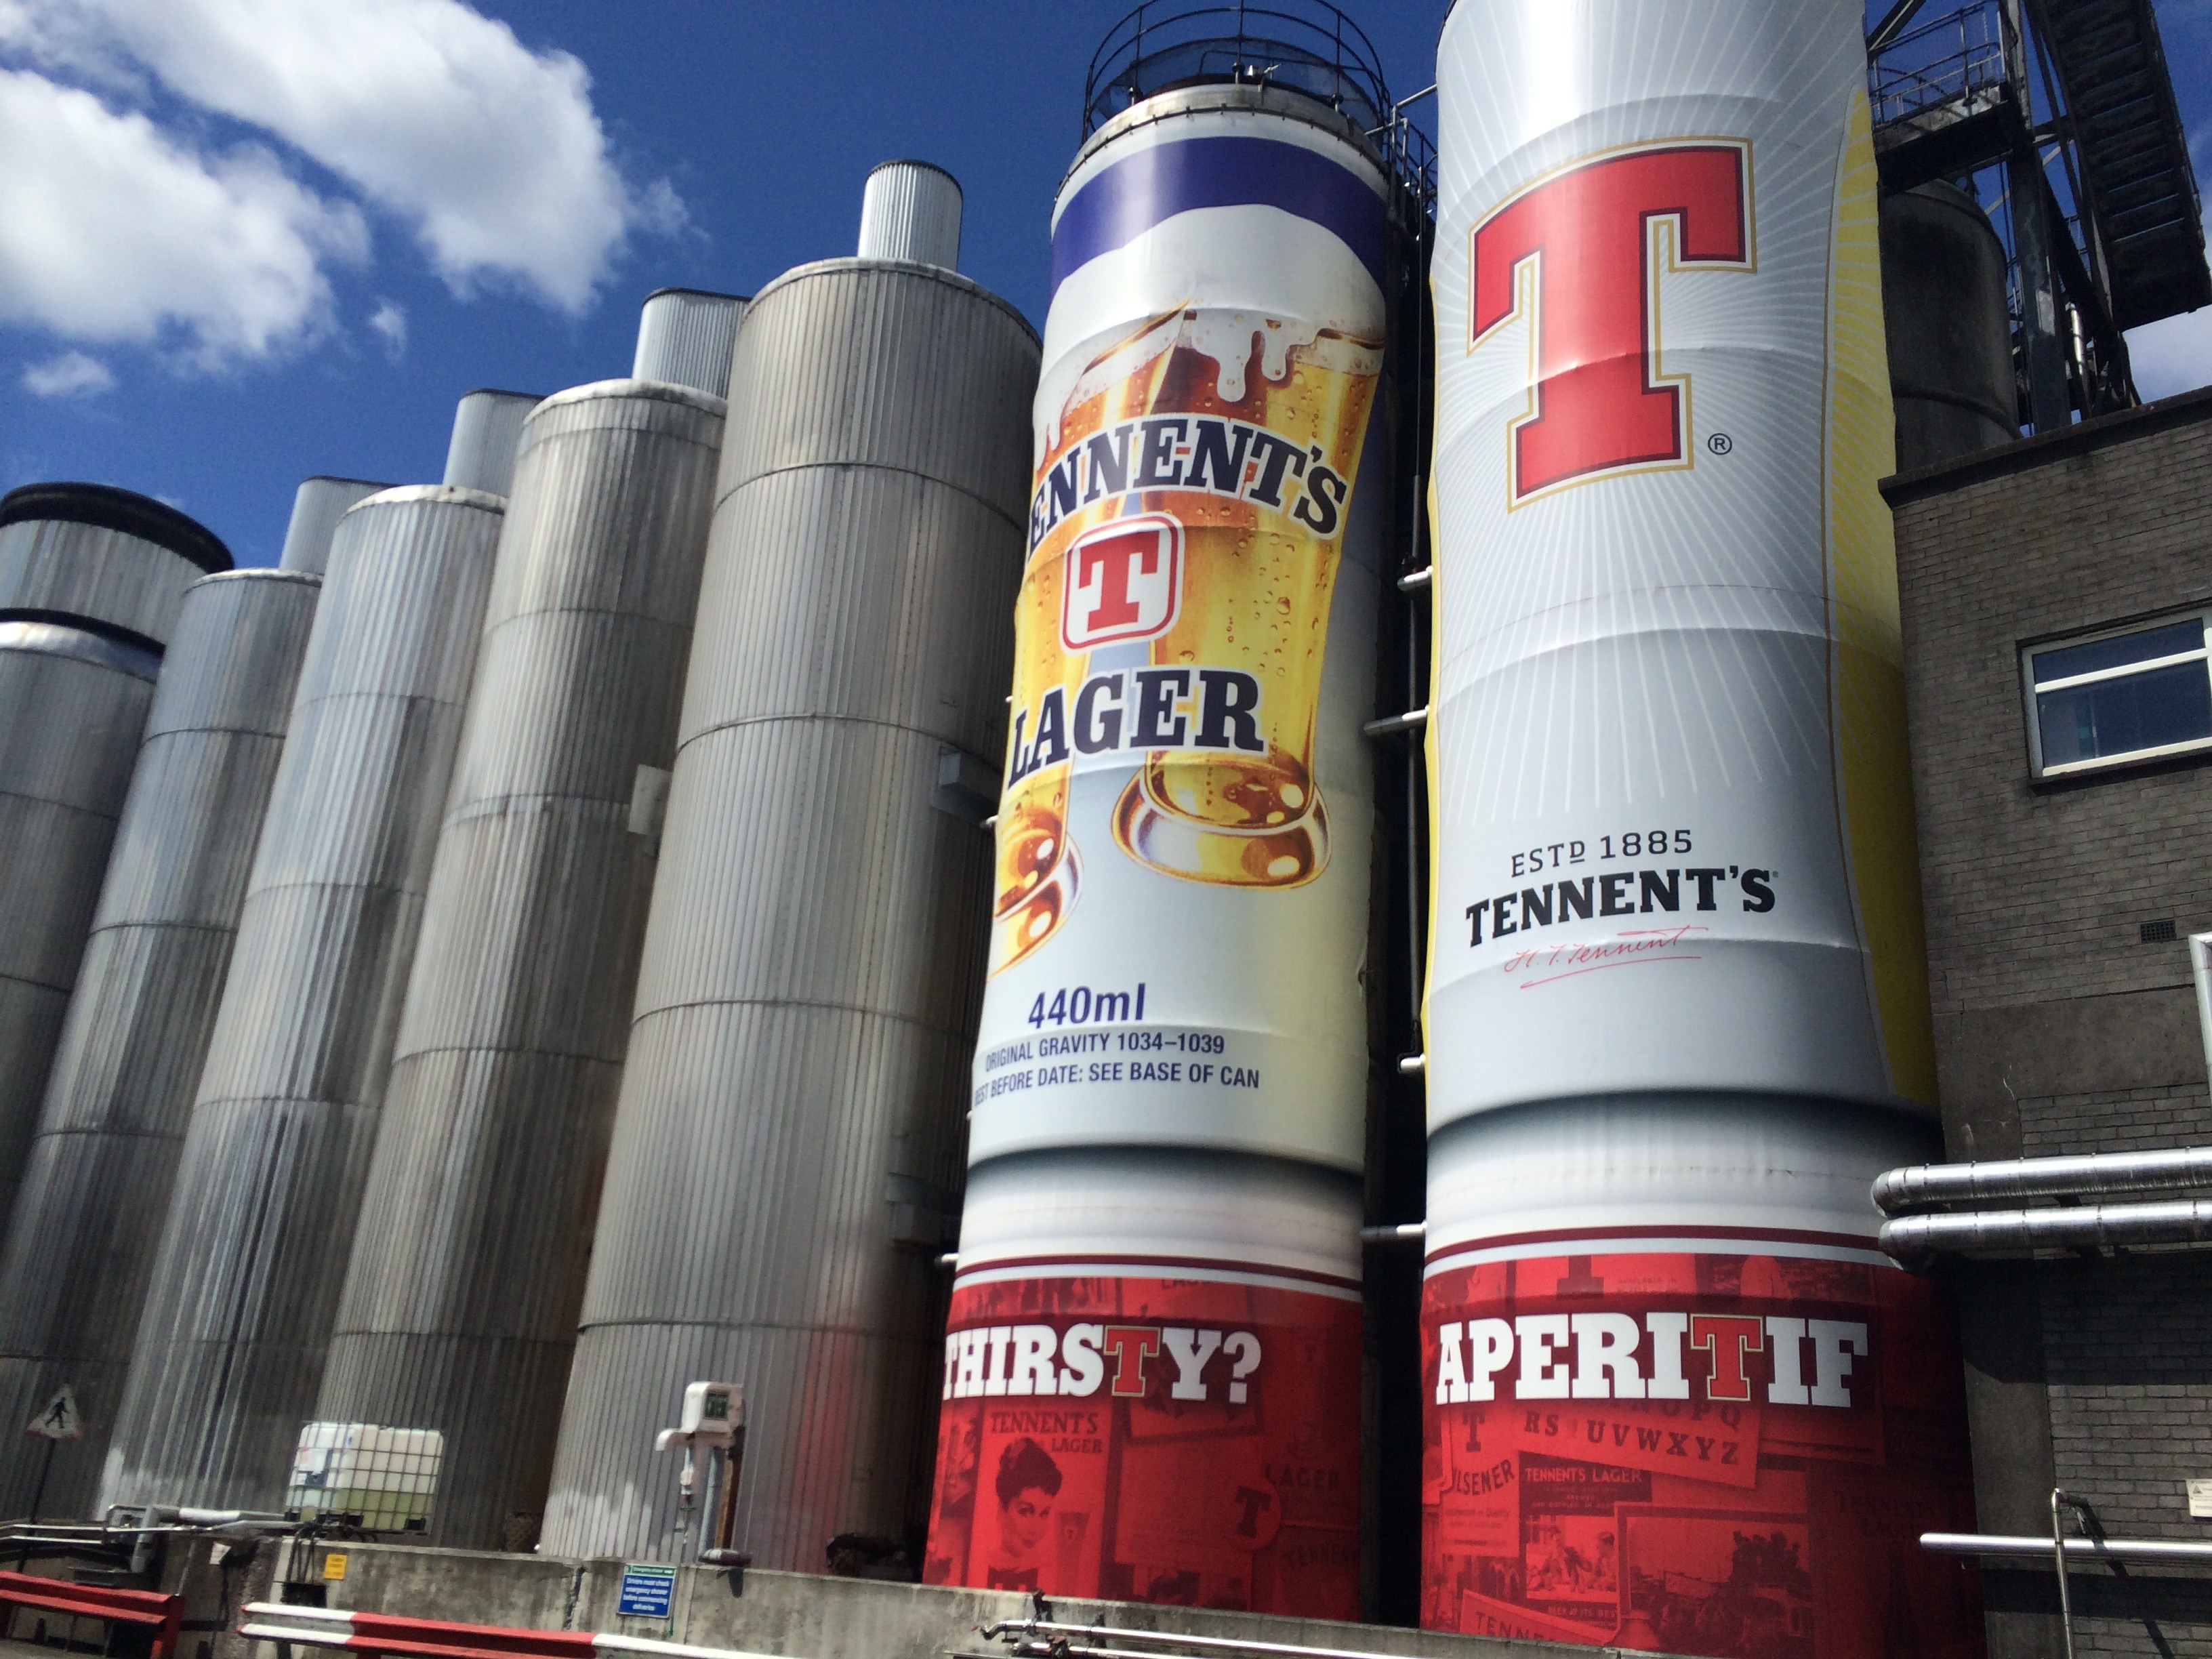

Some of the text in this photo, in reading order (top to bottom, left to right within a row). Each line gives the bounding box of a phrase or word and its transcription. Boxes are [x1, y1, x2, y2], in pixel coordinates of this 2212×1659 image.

[1467, 136, 1758, 514] T
[1028, 417, 1347, 559] ENNENT'S
[1078, 529, 1161, 632] T
[1008, 669, 1265, 787] LAGER
[1599, 829, 1692, 859] 1885
[1465, 865, 1776, 947] TENNENT'S
[1028, 982, 1147, 1029] 440ml
[986, 1042, 1034, 1072] ORIGINAL
[1039, 1032, 1111, 1057] GRAVITY
[991, 1069, 1034, 1098] BEFORE
[1038, 1064, 1083, 1086] DATE:
[1089, 1061, 1123, 1082] SEE
[1130, 1061, 1182, 1082] BASE
[1189, 1063, 1214, 1084] OF
[1221, 1065, 1260, 1088] CAN
[942, 1323, 1262, 1405] THIRSTY?
[1435, 1312, 1868, 1408] APERITIF
